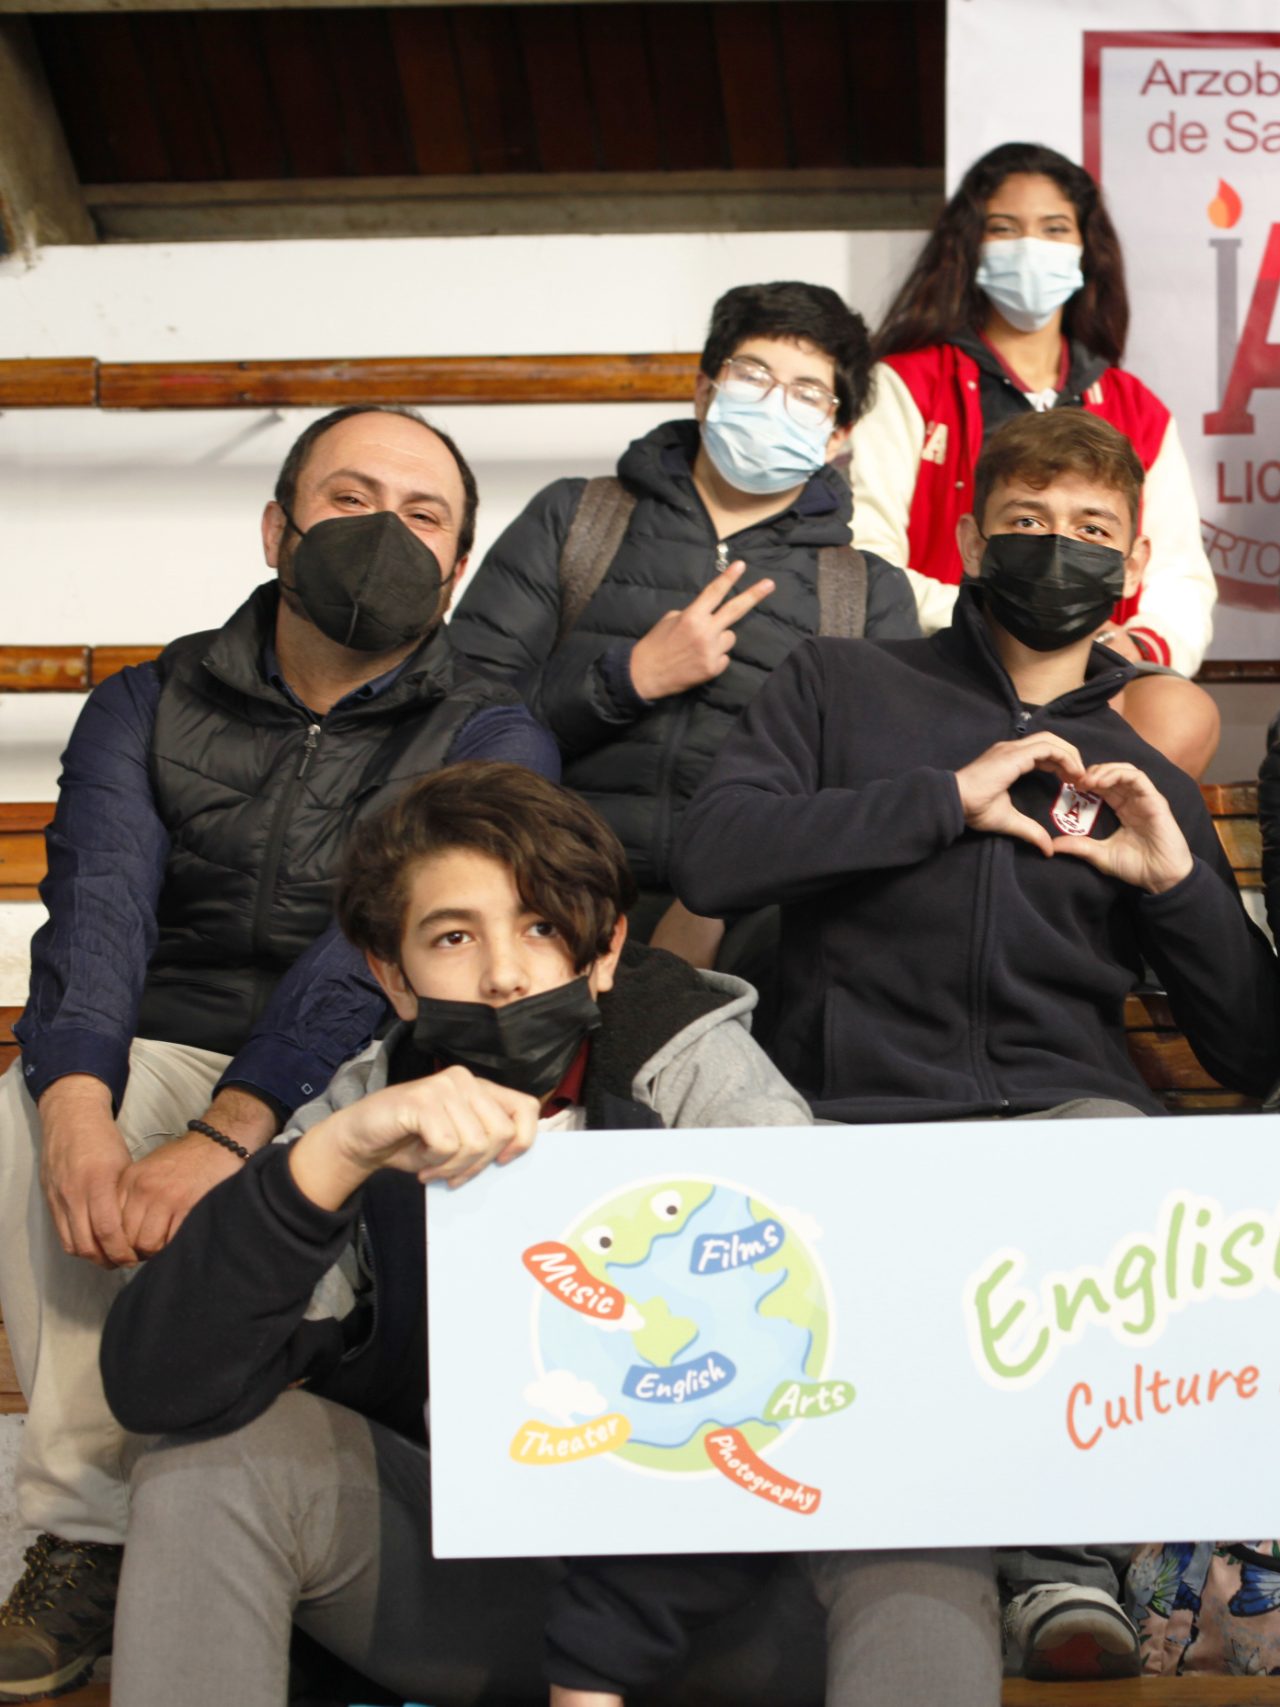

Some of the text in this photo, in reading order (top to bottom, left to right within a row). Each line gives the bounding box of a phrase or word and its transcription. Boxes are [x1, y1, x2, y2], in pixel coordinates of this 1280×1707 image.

[1147, 110, 1209, 154] de
[698, 1224, 780, 1273] Films
[532, 1252, 615, 1315] Music
[635, 1359, 726, 1402] English
[771, 1383, 848, 1417] Arts
[1066, 1364, 1260, 1451] Culture
[519, 1416, 619, 1458] Theater
[710, 1434, 817, 1510] Photography
